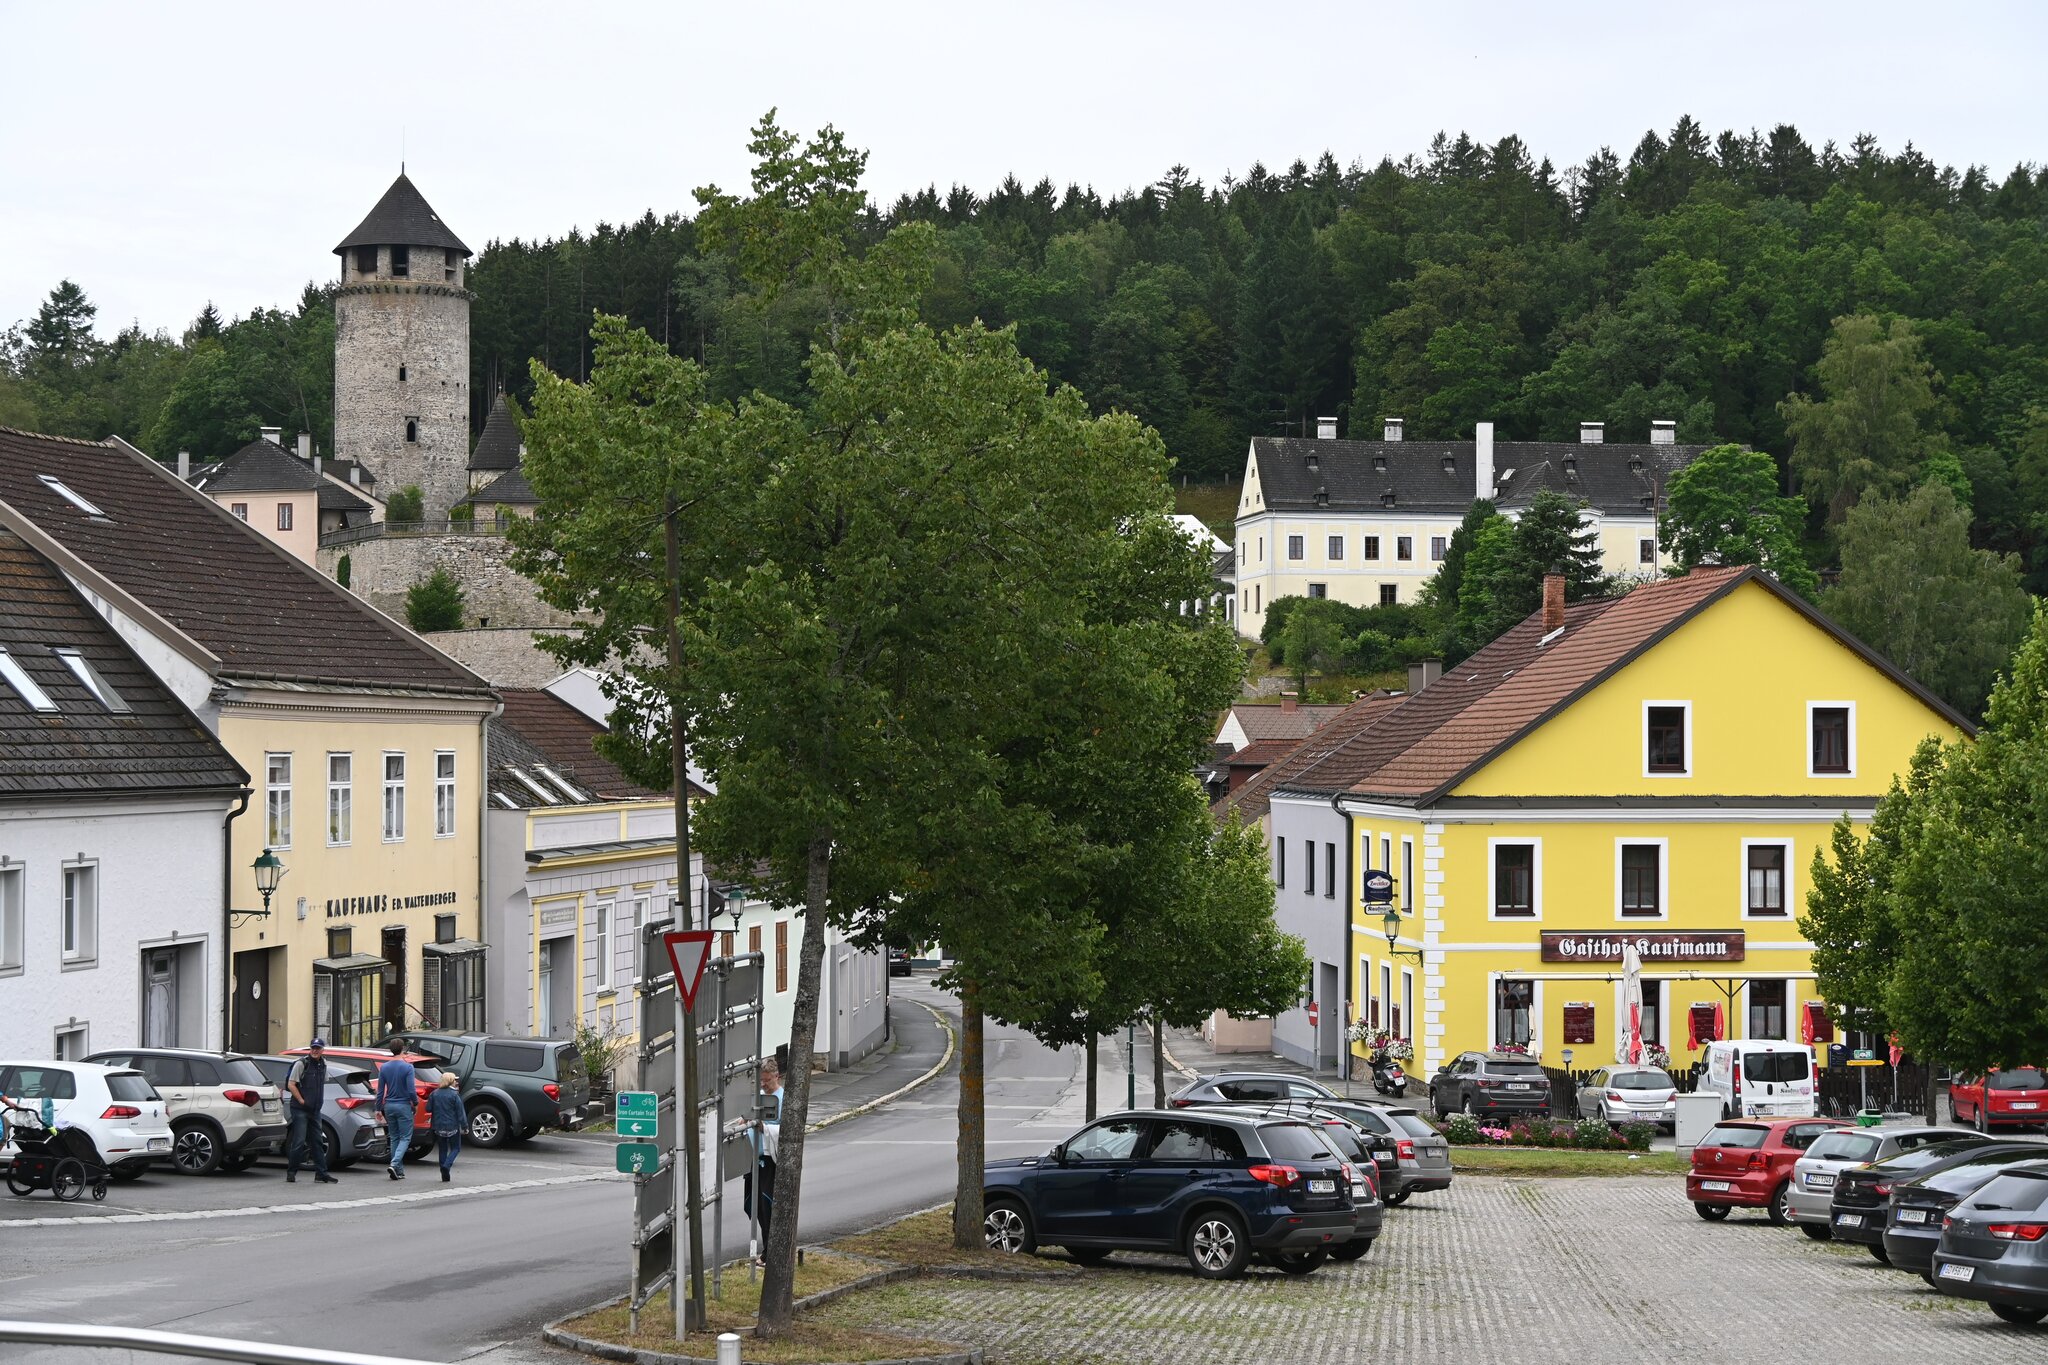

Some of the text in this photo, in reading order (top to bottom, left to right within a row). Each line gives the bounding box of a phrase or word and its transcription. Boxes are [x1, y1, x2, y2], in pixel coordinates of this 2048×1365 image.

[326, 894, 388, 918] KAUFHAUS
[404, 891, 457, 909] WALTENBERGER
[1635, 938, 1728, 959] Kaufmann
